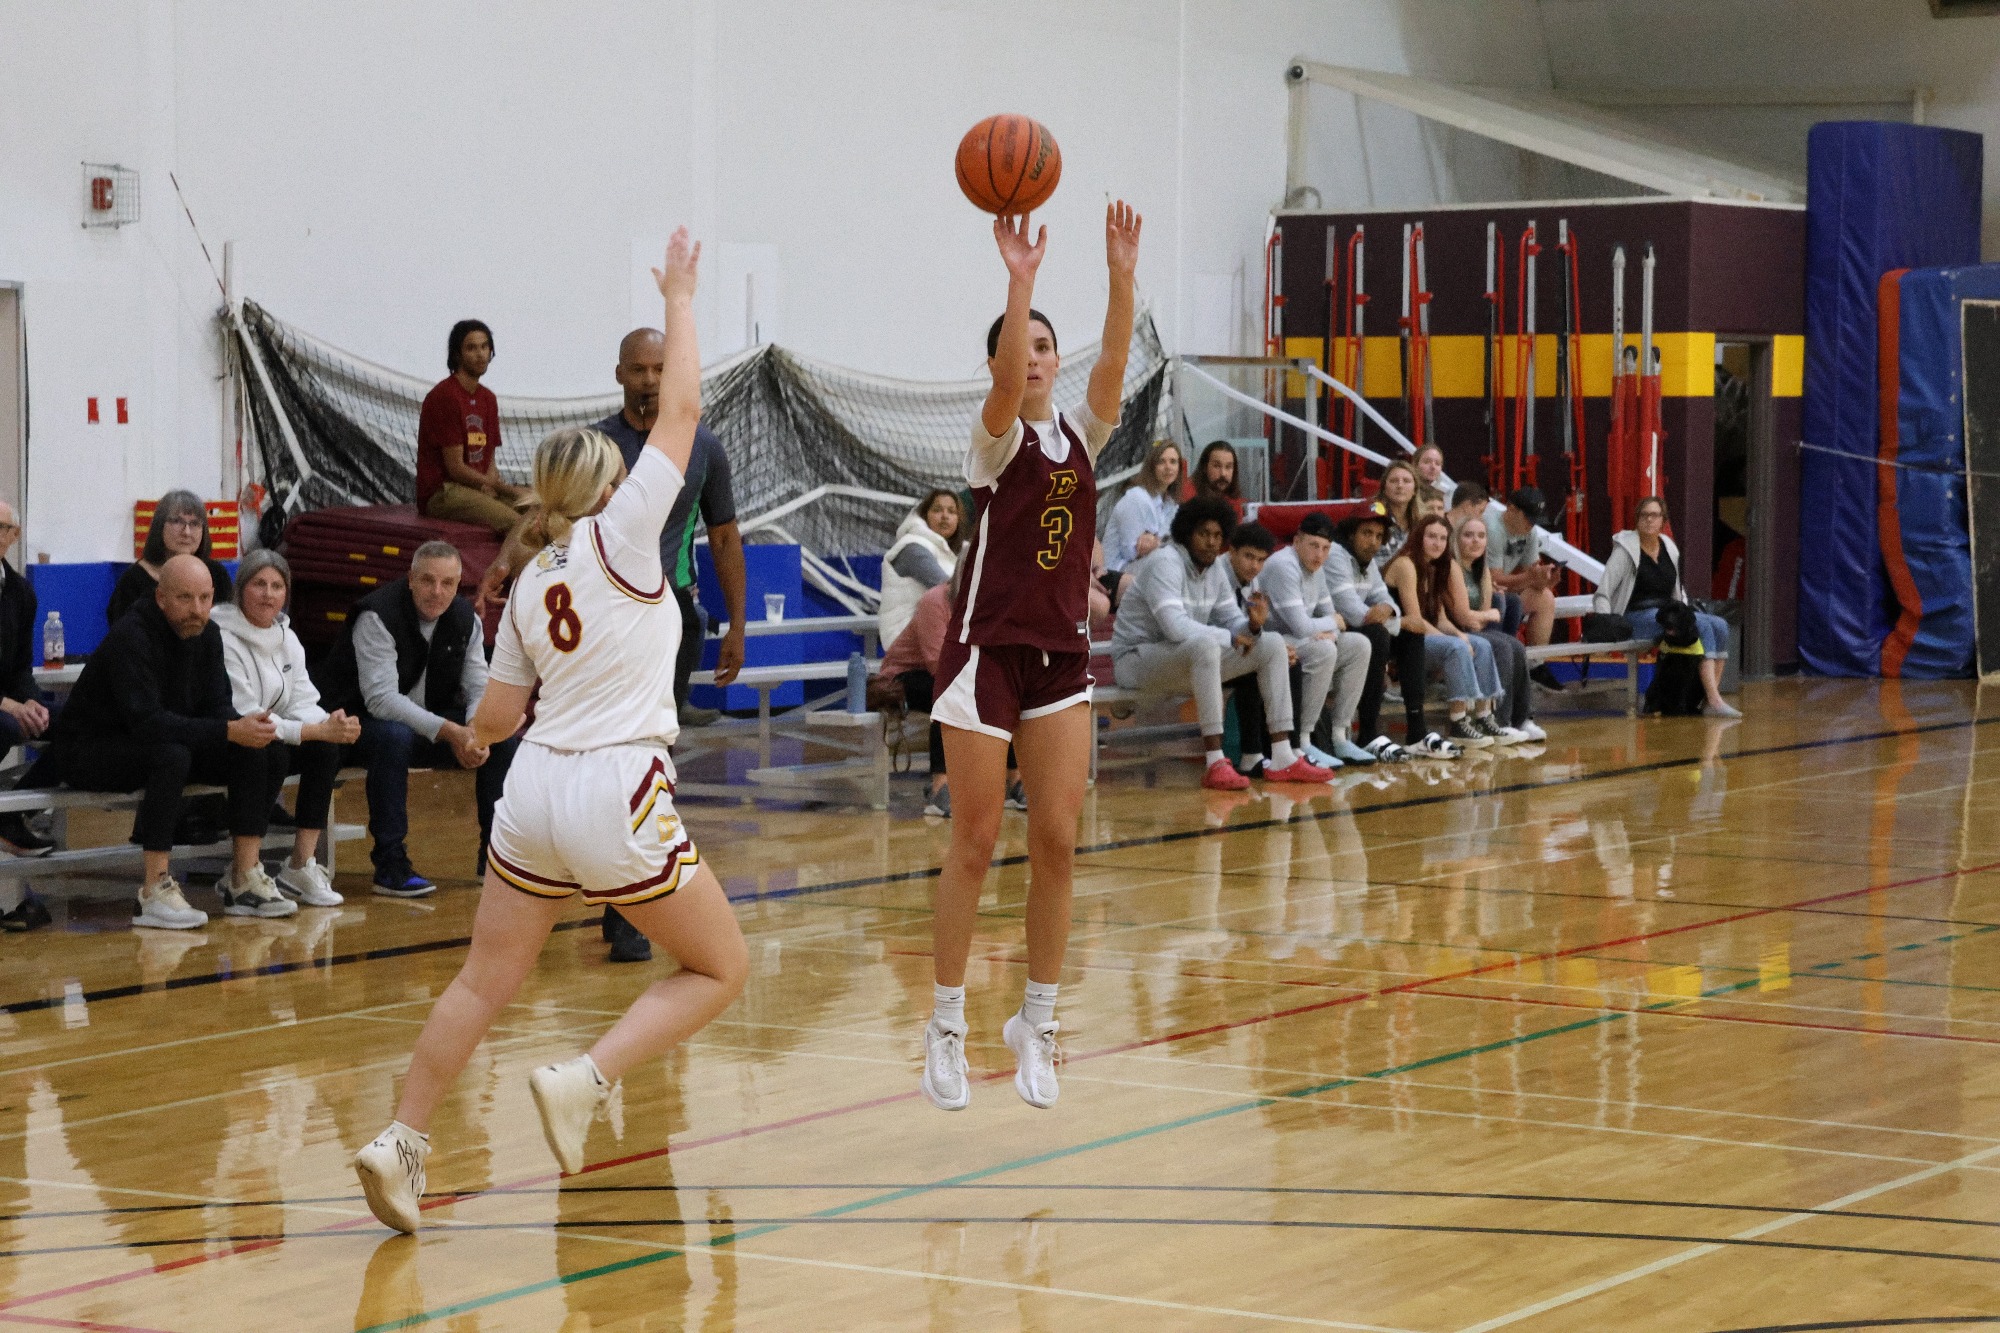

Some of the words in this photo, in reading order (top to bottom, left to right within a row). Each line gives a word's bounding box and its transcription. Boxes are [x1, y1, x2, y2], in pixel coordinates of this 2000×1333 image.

[1046, 470, 1077, 501] E
[1037, 506, 1072, 570] 3
[545, 582, 582, 653] 8
